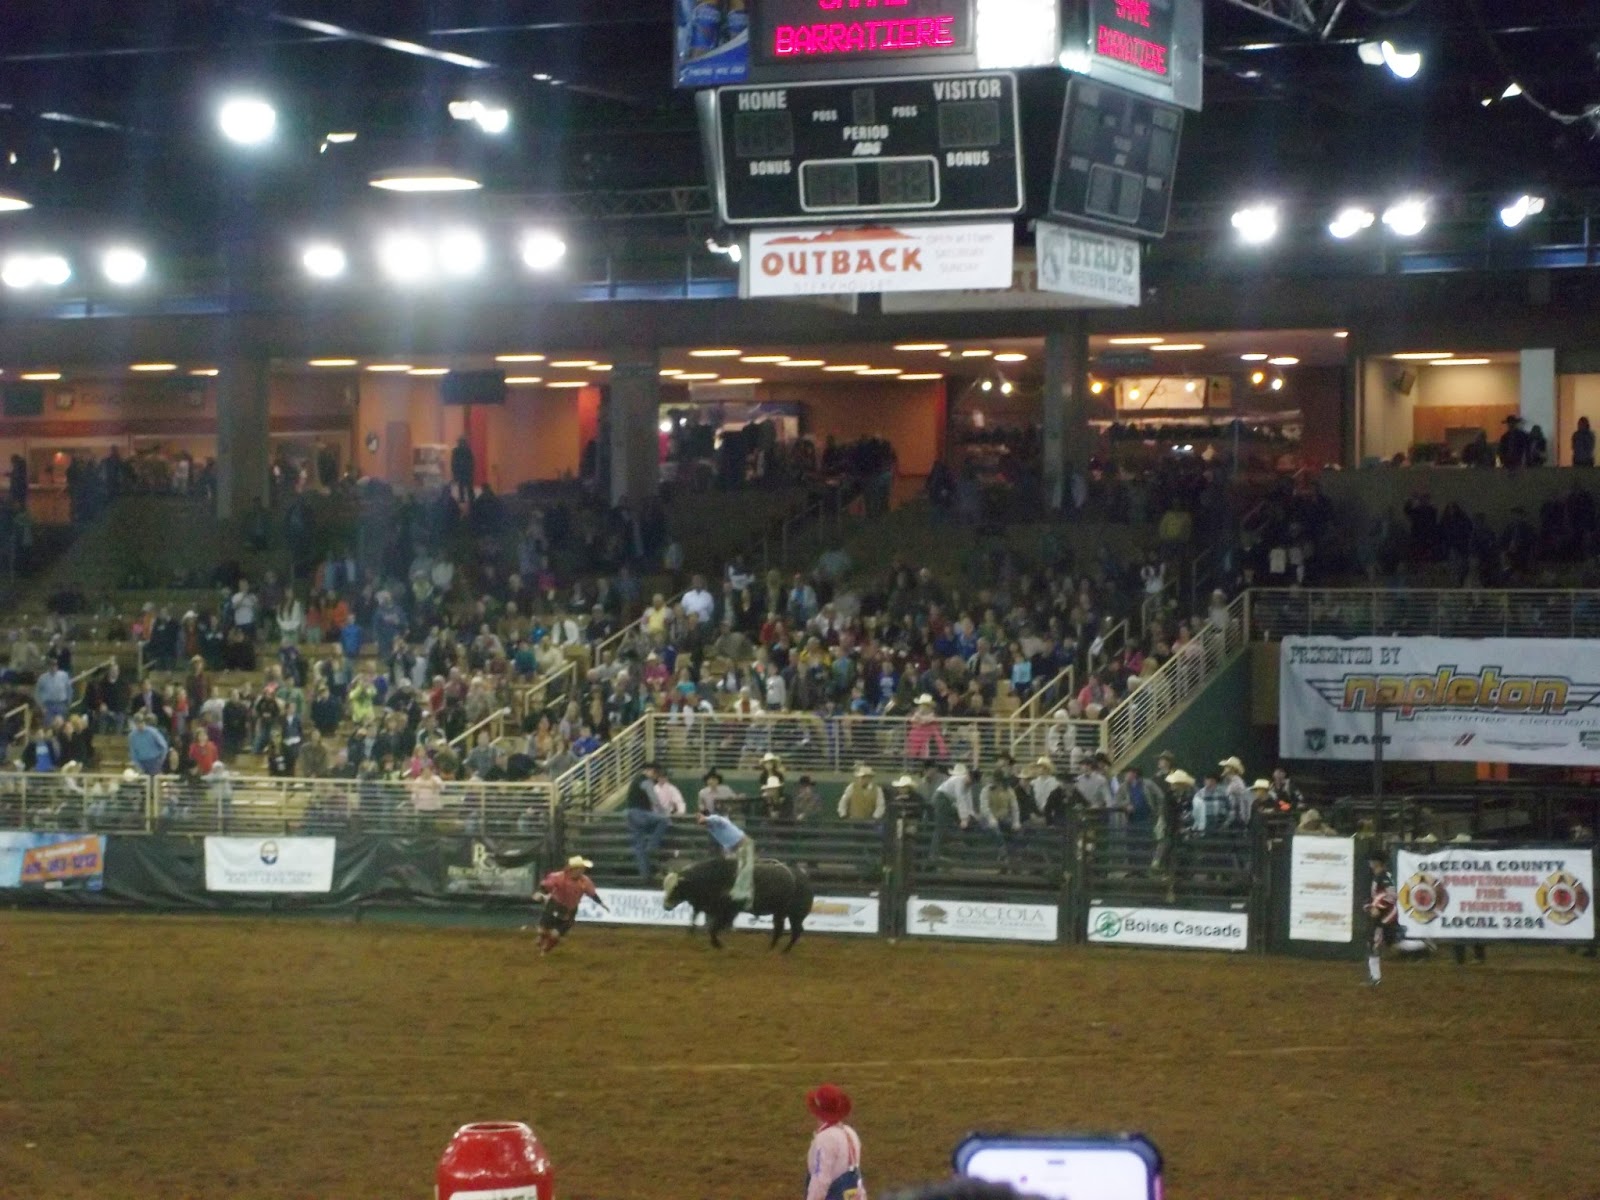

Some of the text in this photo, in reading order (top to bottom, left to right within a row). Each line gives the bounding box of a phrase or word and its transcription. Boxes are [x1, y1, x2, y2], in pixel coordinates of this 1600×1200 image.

[775, 16, 955, 56] BARRATIERE
[933, 79, 1001, 101] VISITOR
[738, 90, 787, 110] HOME
[843, 125, 889, 141] PERIOD
[750, 160, 791, 176] BONUS
[946, 151, 989, 167] BONUS
[761, 247, 923, 276] OUTBACK
[1290, 646, 1402, 665] PRESENTED BY
[1341, 666, 1570, 719] napleton
[1333, 734, 1392, 745] RAM
[1418, 860, 1565, 872] OSCEOLA COUNTY
[956, 905, 1044, 922] OSCEOLA
[1124, 918, 1241, 938] Boise Cascade
[1441, 916, 1545, 930] LOCAL 3284
